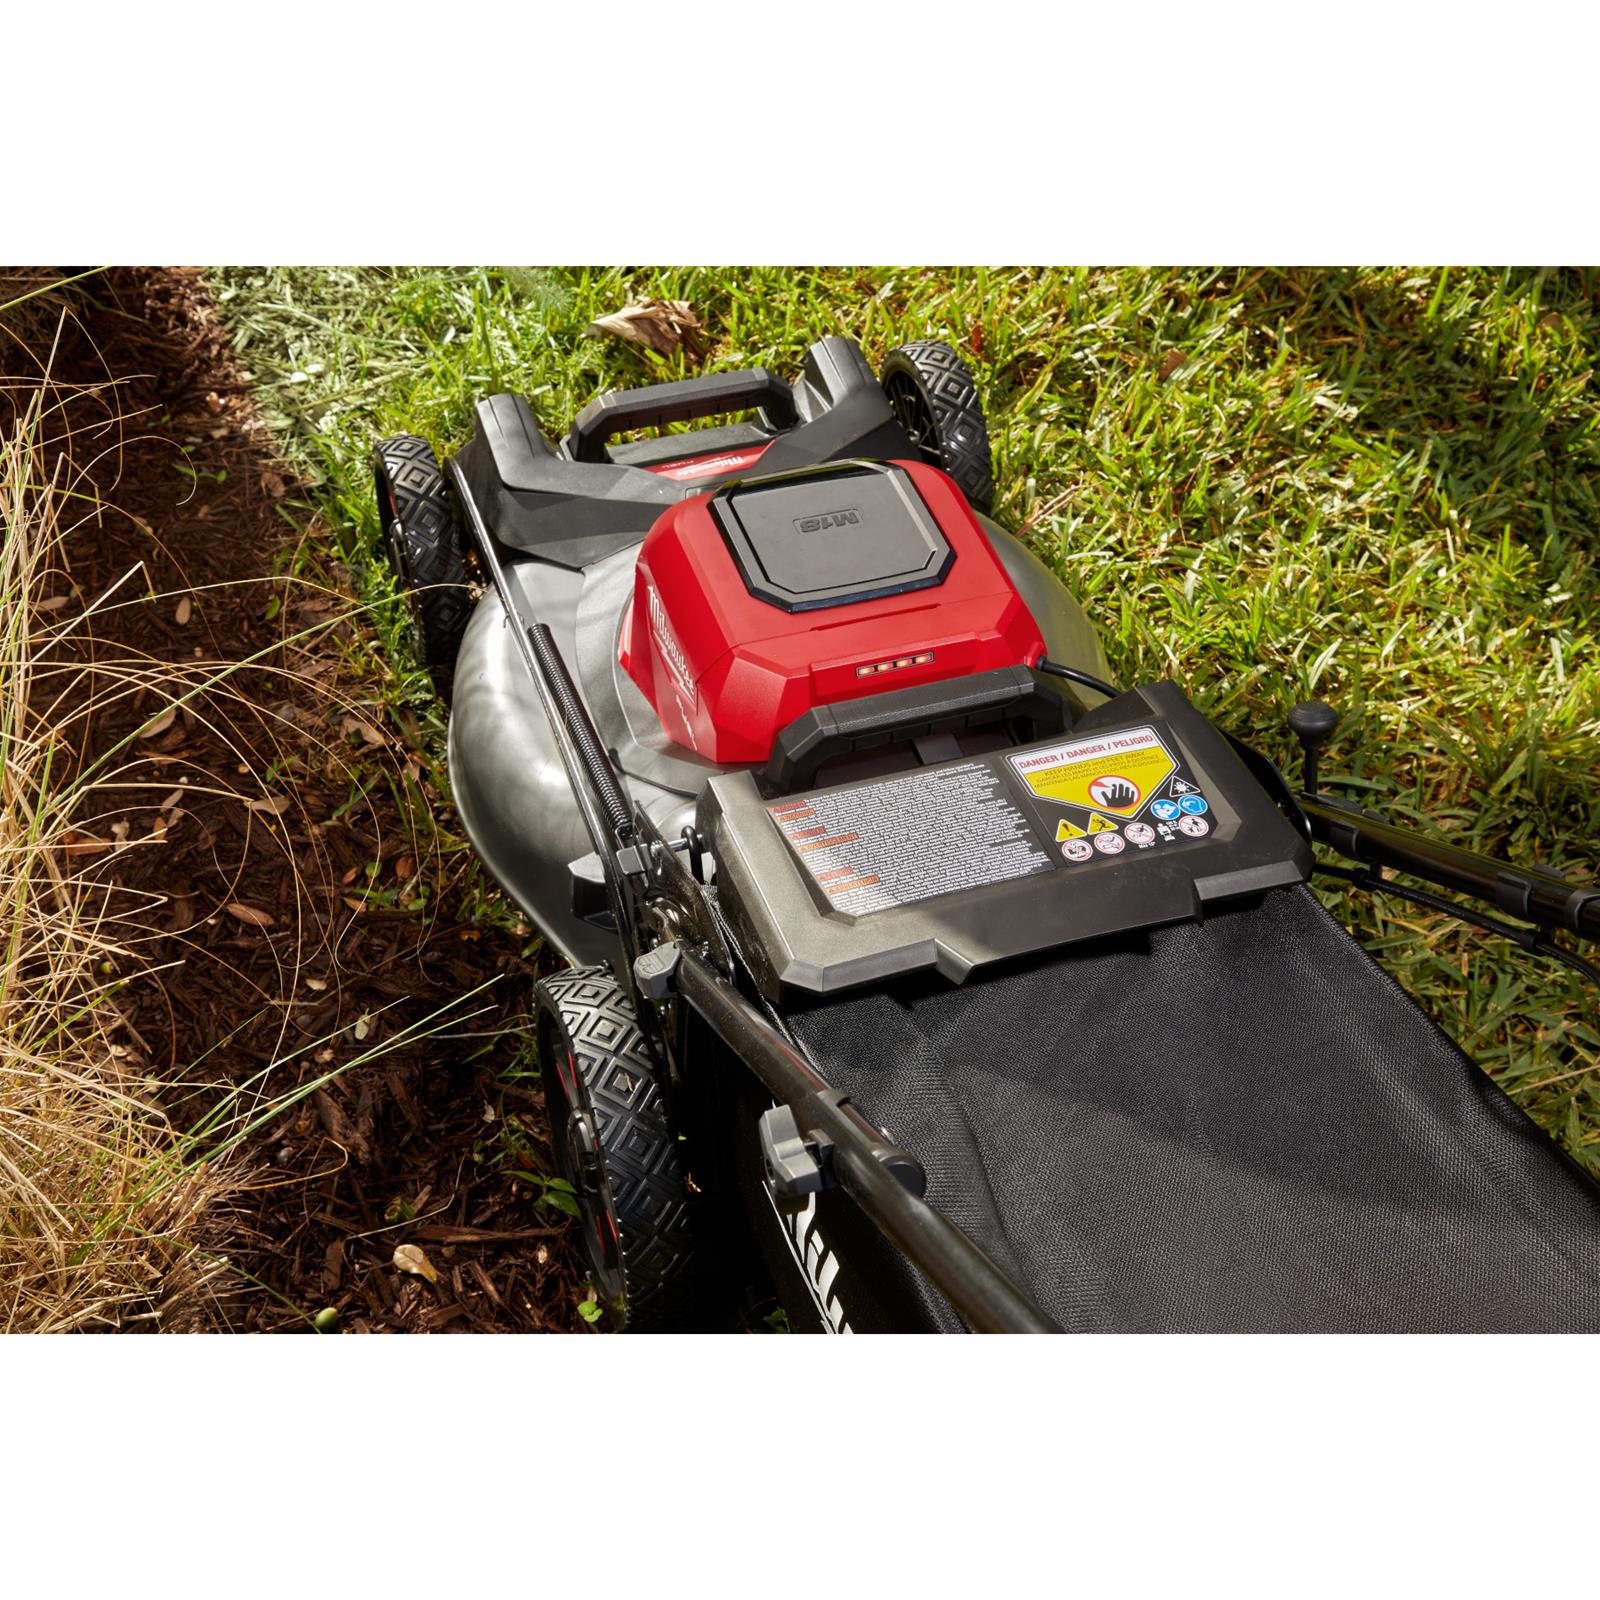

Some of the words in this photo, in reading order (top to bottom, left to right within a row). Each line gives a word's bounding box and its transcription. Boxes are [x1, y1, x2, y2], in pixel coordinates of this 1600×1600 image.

[800, 511, 859, 533] M18
[648, 586, 694, 695] Milwaukee
[1018, 754, 1059, 769] DANGER
[1066, 744, 1106, 758] DANGER
[1112, 734, 1153, 748] PELIGRO
